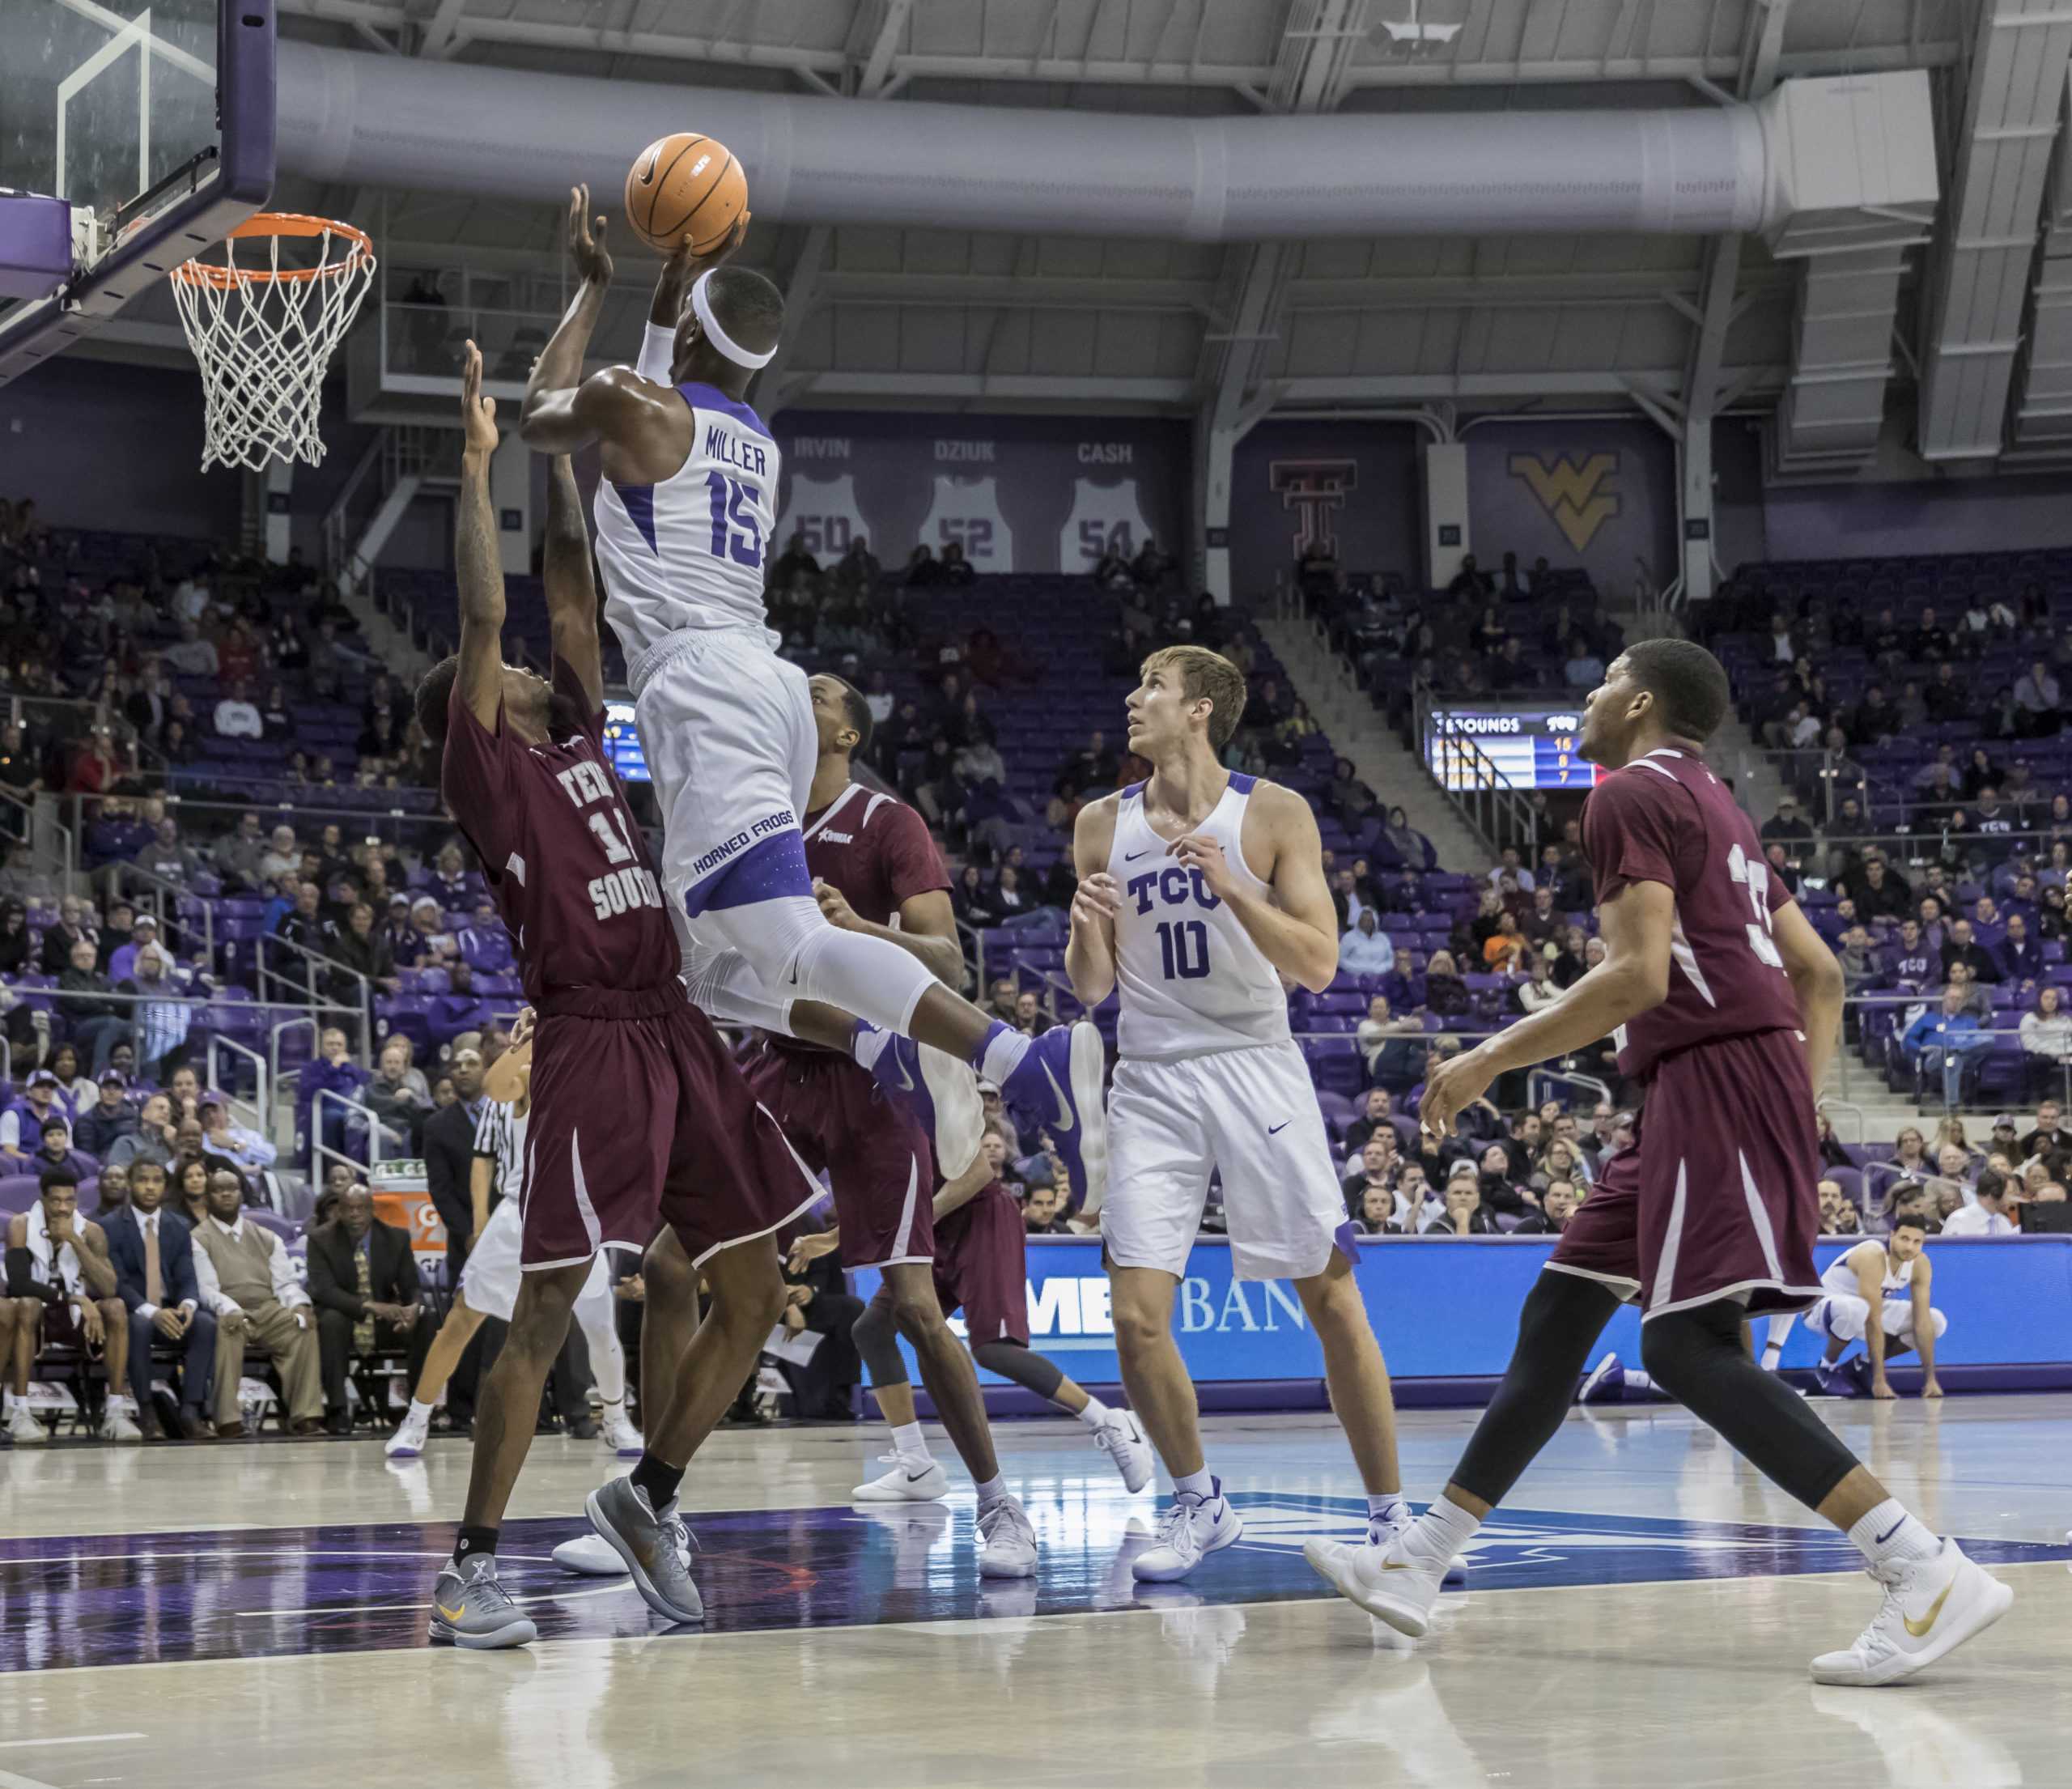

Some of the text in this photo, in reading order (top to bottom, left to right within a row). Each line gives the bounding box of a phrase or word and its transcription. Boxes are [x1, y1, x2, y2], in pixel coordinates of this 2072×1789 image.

[706, 425, 766, 476] MILLER
[794, 436, 851, 459] IRVIN
[934, 440, 996, 462] DZIUK
[1077, 442, 1133, 464] CASH
[704, 470, 762, 569] 15
[939, 518, 994, 558] 52
[1079, 520, 1132, 559] 54
[693, 810, 794, 874] HORNED FROGS
[1127, 867, 1221, 916] TCU
[1155, 920, 1211, 980] 10
[1898, 958, 1927, 975] TCU
[418, 1204, 439, 1227] G
[1180, 1277, 1307, 1333] BAN
